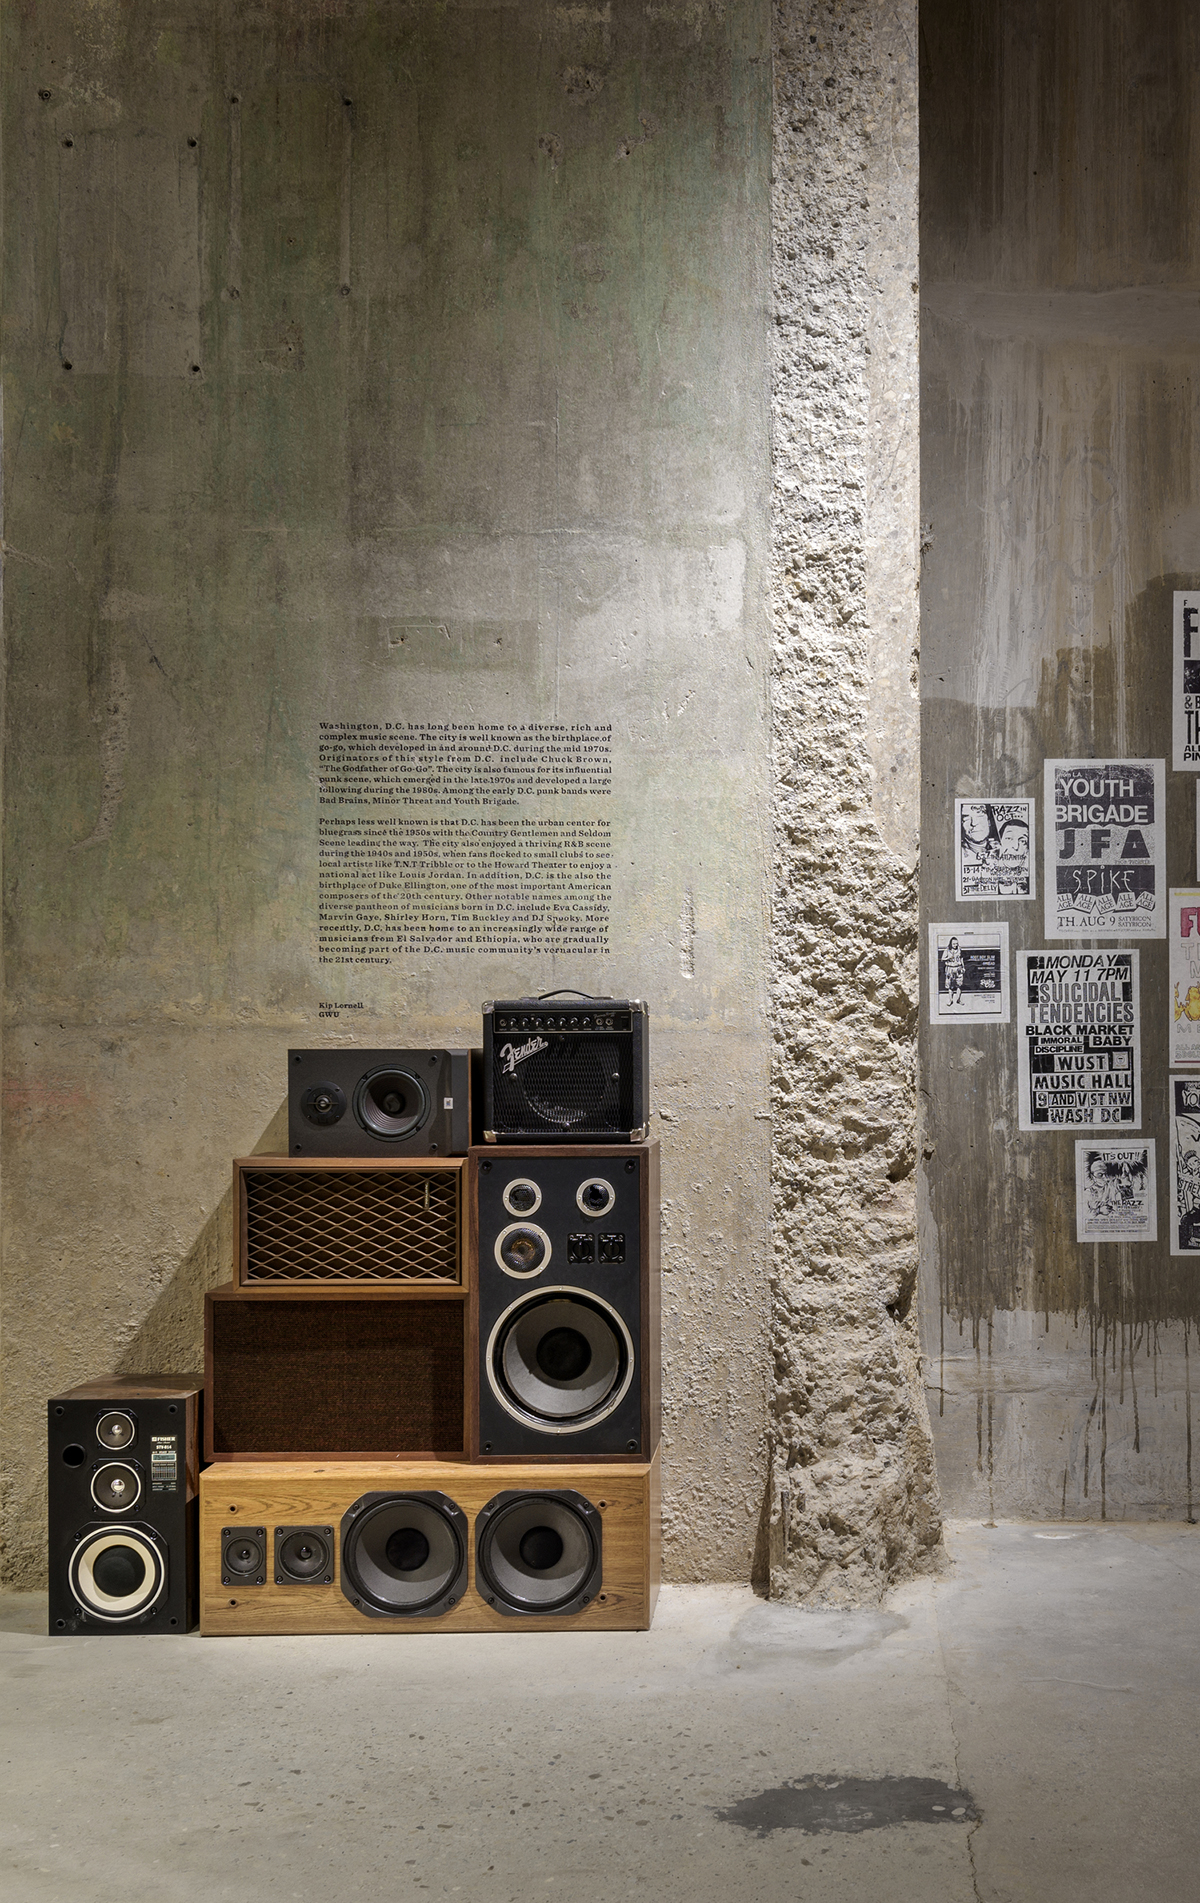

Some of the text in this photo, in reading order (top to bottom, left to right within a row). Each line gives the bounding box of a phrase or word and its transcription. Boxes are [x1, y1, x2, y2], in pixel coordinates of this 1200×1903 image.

[427, 723, 449, 731] long
[528, 724, 568, 732] diverse,
[1060, 778, 1134, 797] YOUTH
[339, 797, 370, 805] Brains,
[483, 798, 519, 806] Brigade.
[1055, 805, 1148, 823] BRIGADE
[1046, 954, 1118, 969] MONDAY
[1031, 968, 1128, 984] MAY 11 7PM
[1039, 982, 1121, 1003] SUICIDAL
[319, 1002, 332, 1010] Kip
[1028, 1002, 1134, 1023] TENDENCIES
[1026, 1025, 1134, 1036] BLACK MARKET
[1093, 1036, 1132, 1046] BABY
[500, 1036, 548, 1073] Fender
[1057, 1056, 1105, 1071] WUST
[1034, 1074, 1131, 1089] MUSIC HALL
[1051, 1109, 1120, 1123] WASH DC
